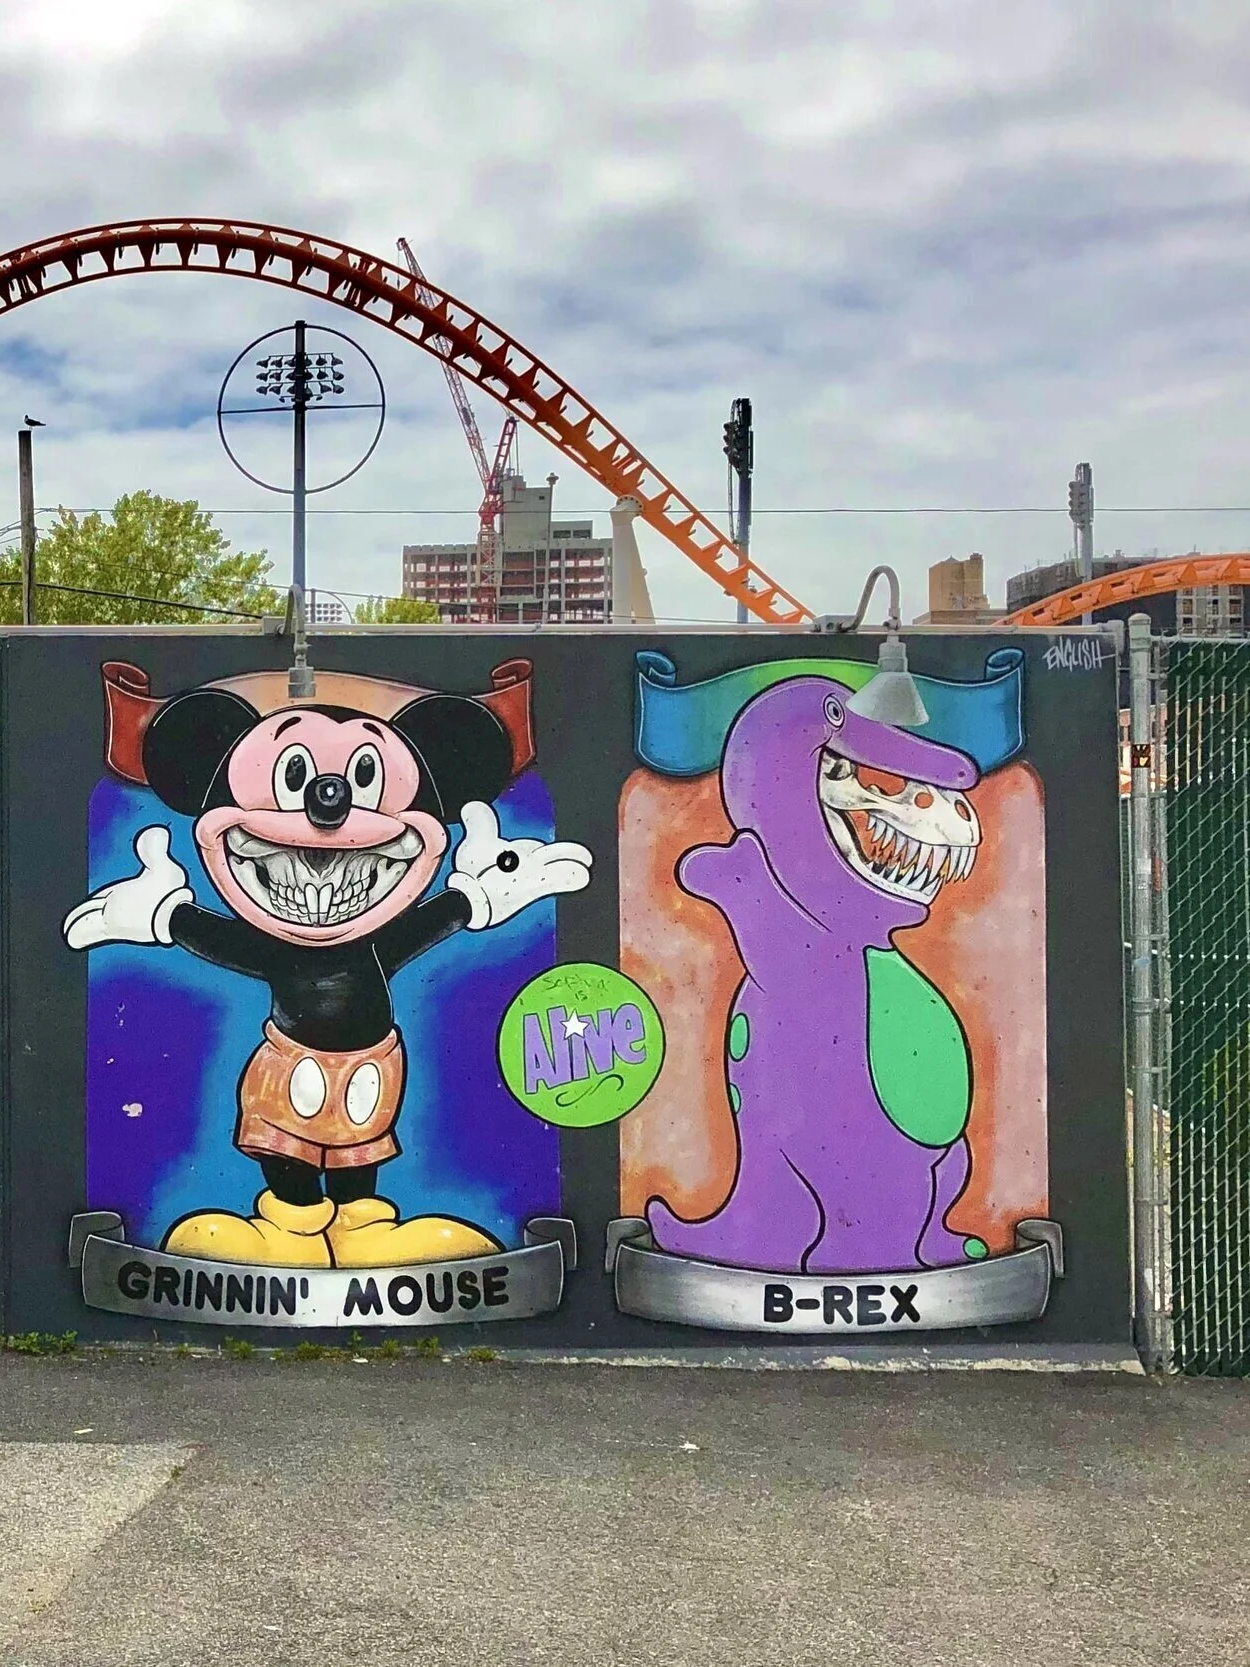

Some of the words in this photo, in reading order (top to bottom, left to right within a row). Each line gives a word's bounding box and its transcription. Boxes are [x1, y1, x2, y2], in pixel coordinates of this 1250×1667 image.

[1042, 636, 1116, 672] ENGLISH
[117, 1261, 309, 1316] GRINNIN'
[343, 1266, 510, 1317] MOUSE
[763, 1284, 921, 1326] B-REX
